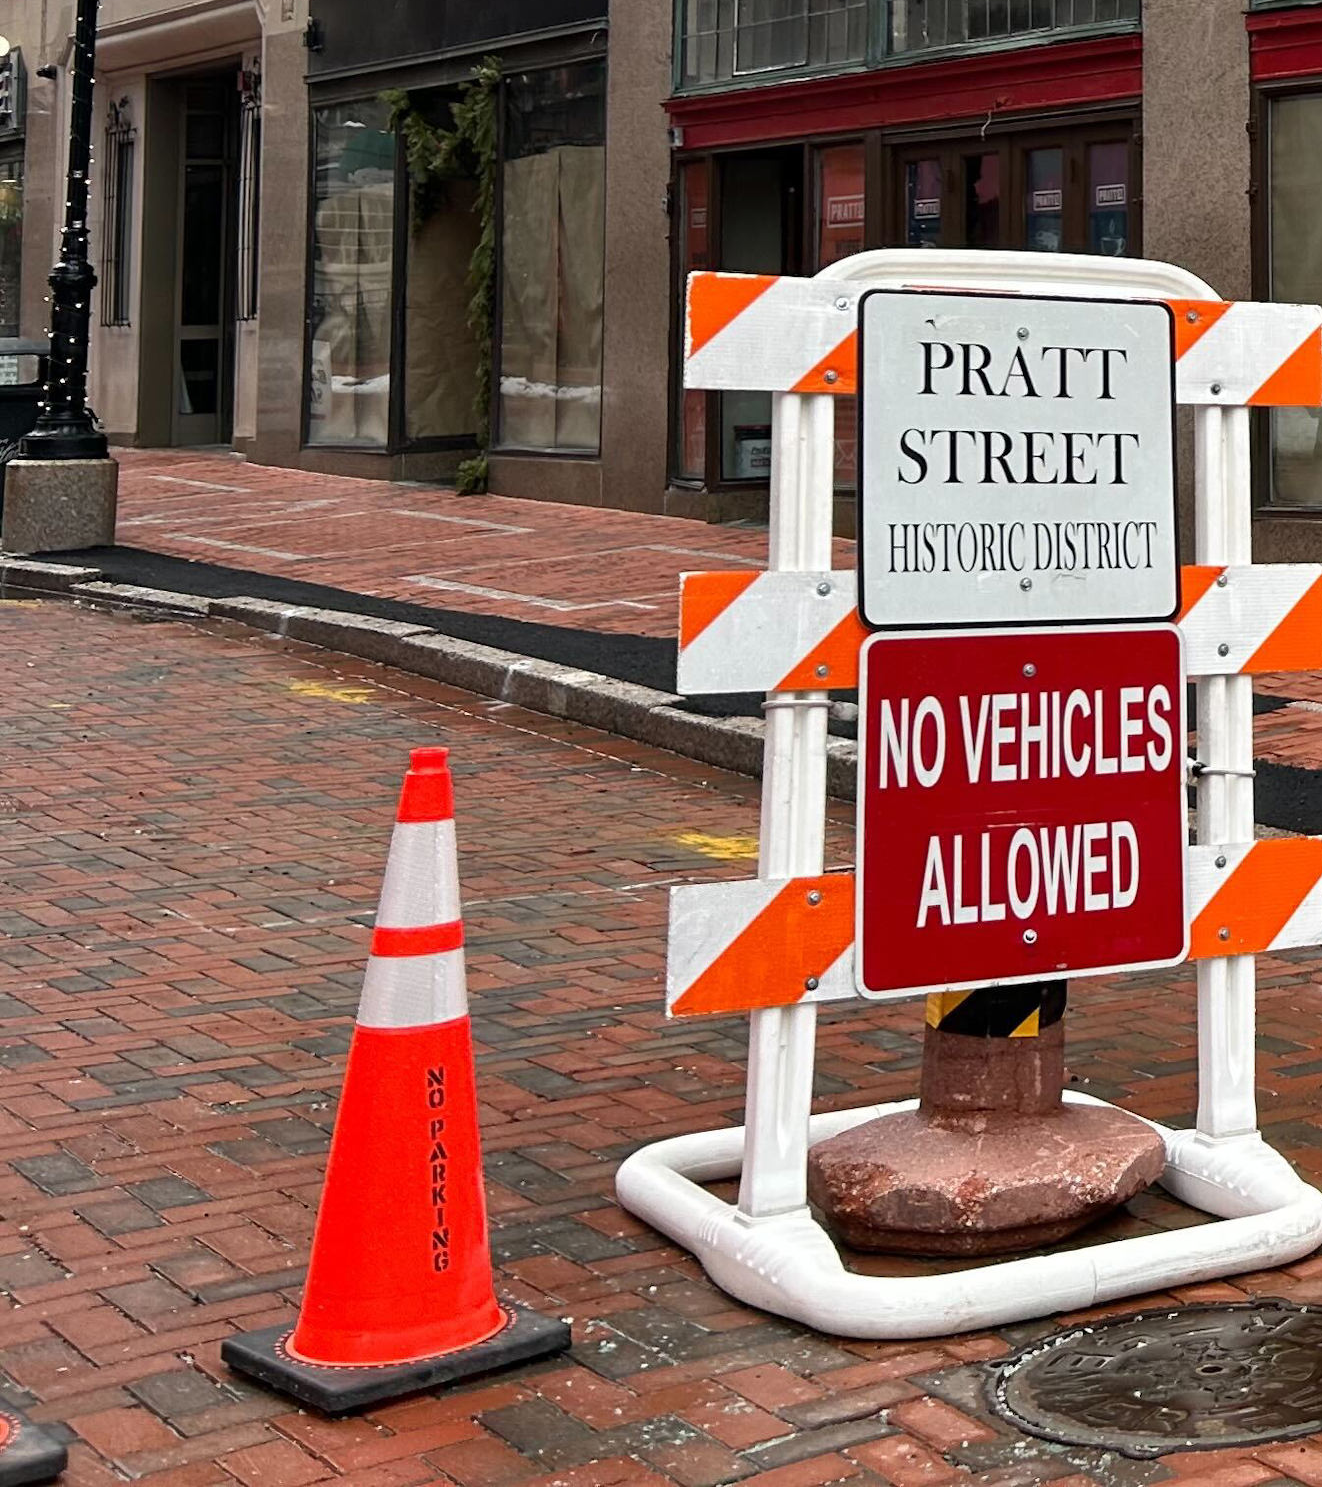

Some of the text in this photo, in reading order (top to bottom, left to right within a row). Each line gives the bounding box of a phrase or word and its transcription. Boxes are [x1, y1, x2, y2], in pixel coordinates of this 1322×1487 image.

[917, 340, 1128, 400] PRATT
[897, 427, 1140, 486] STREET
[888, 520, 1158, 574] HISTORIC DISTRICT
[879, 683, 1173, 790] NO VEHICLES
[916, 819, 1140, 929] ALLOWED
[427, 1066, 450, 1272] NO PARKING
